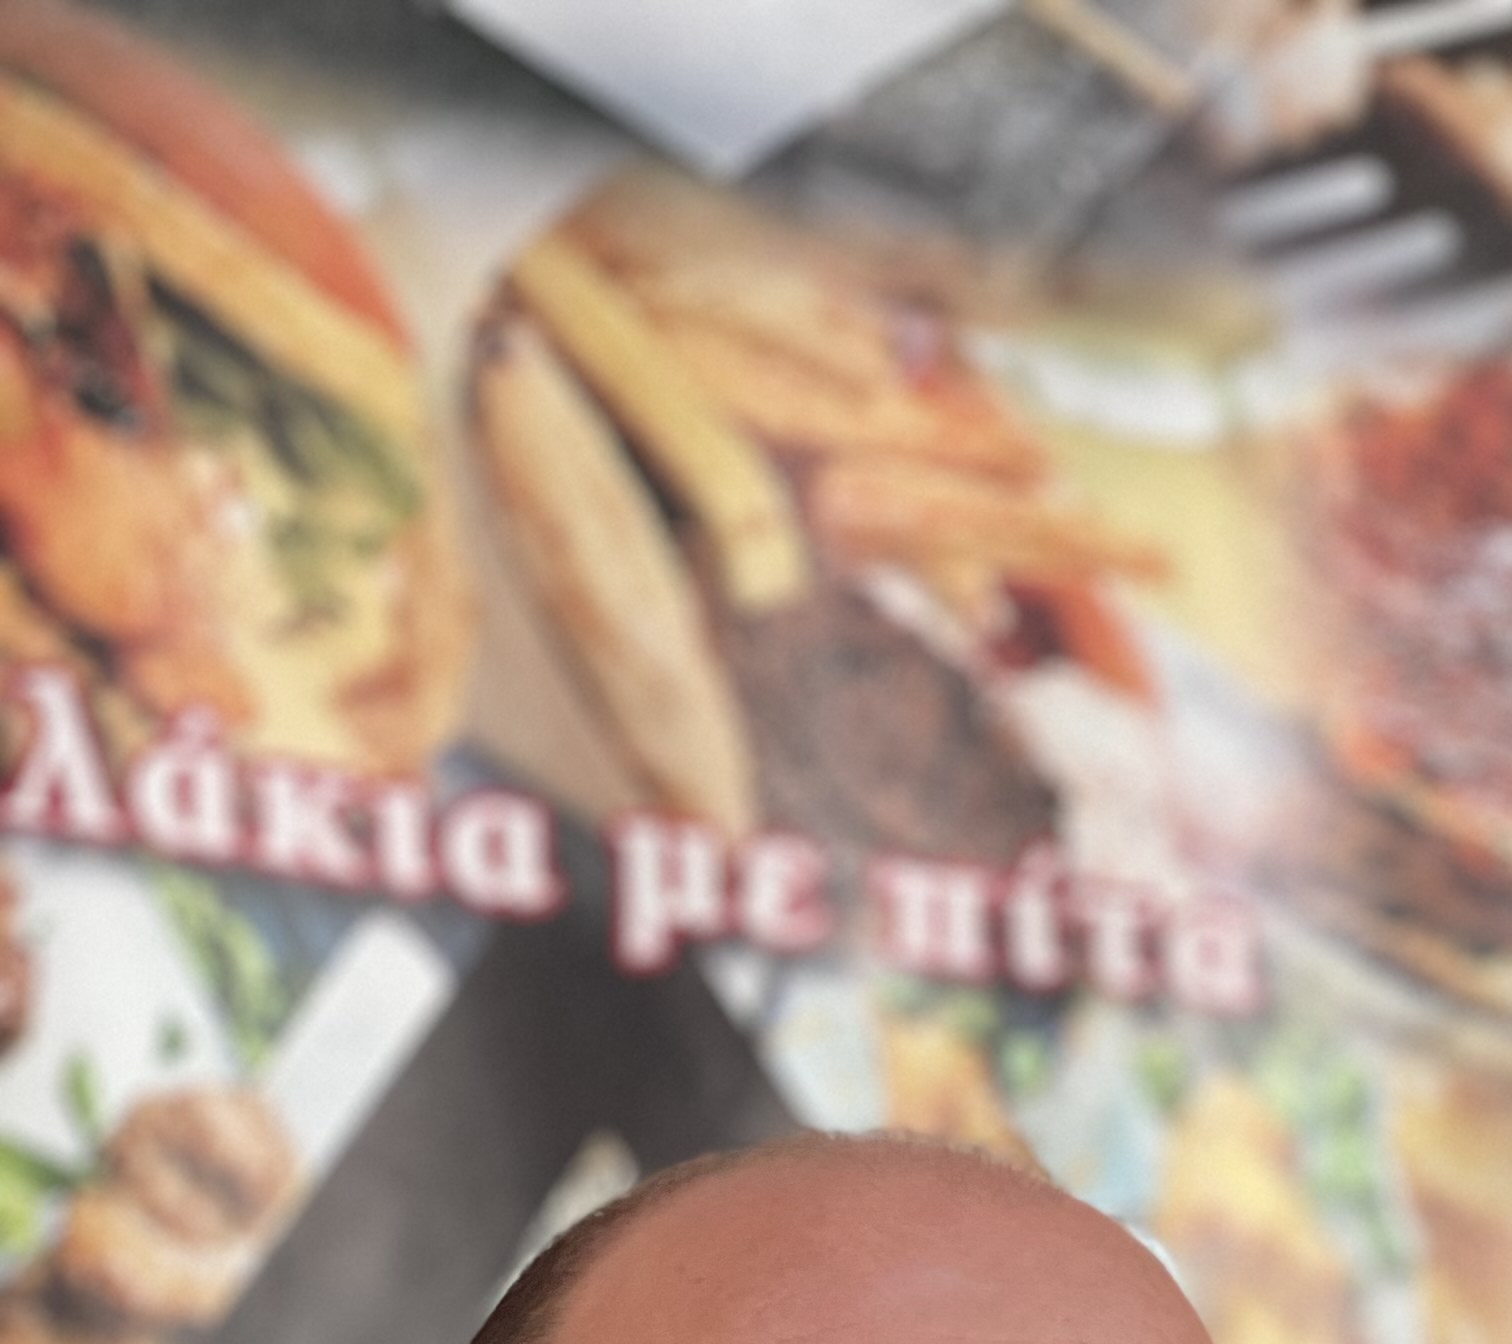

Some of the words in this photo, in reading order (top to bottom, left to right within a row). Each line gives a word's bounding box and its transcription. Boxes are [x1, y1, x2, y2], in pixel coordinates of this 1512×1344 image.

[2, 666, 560, 914] λάκια
[614, 808, 826, 972] με
[872, 845, 1262, 1008] πίτα
